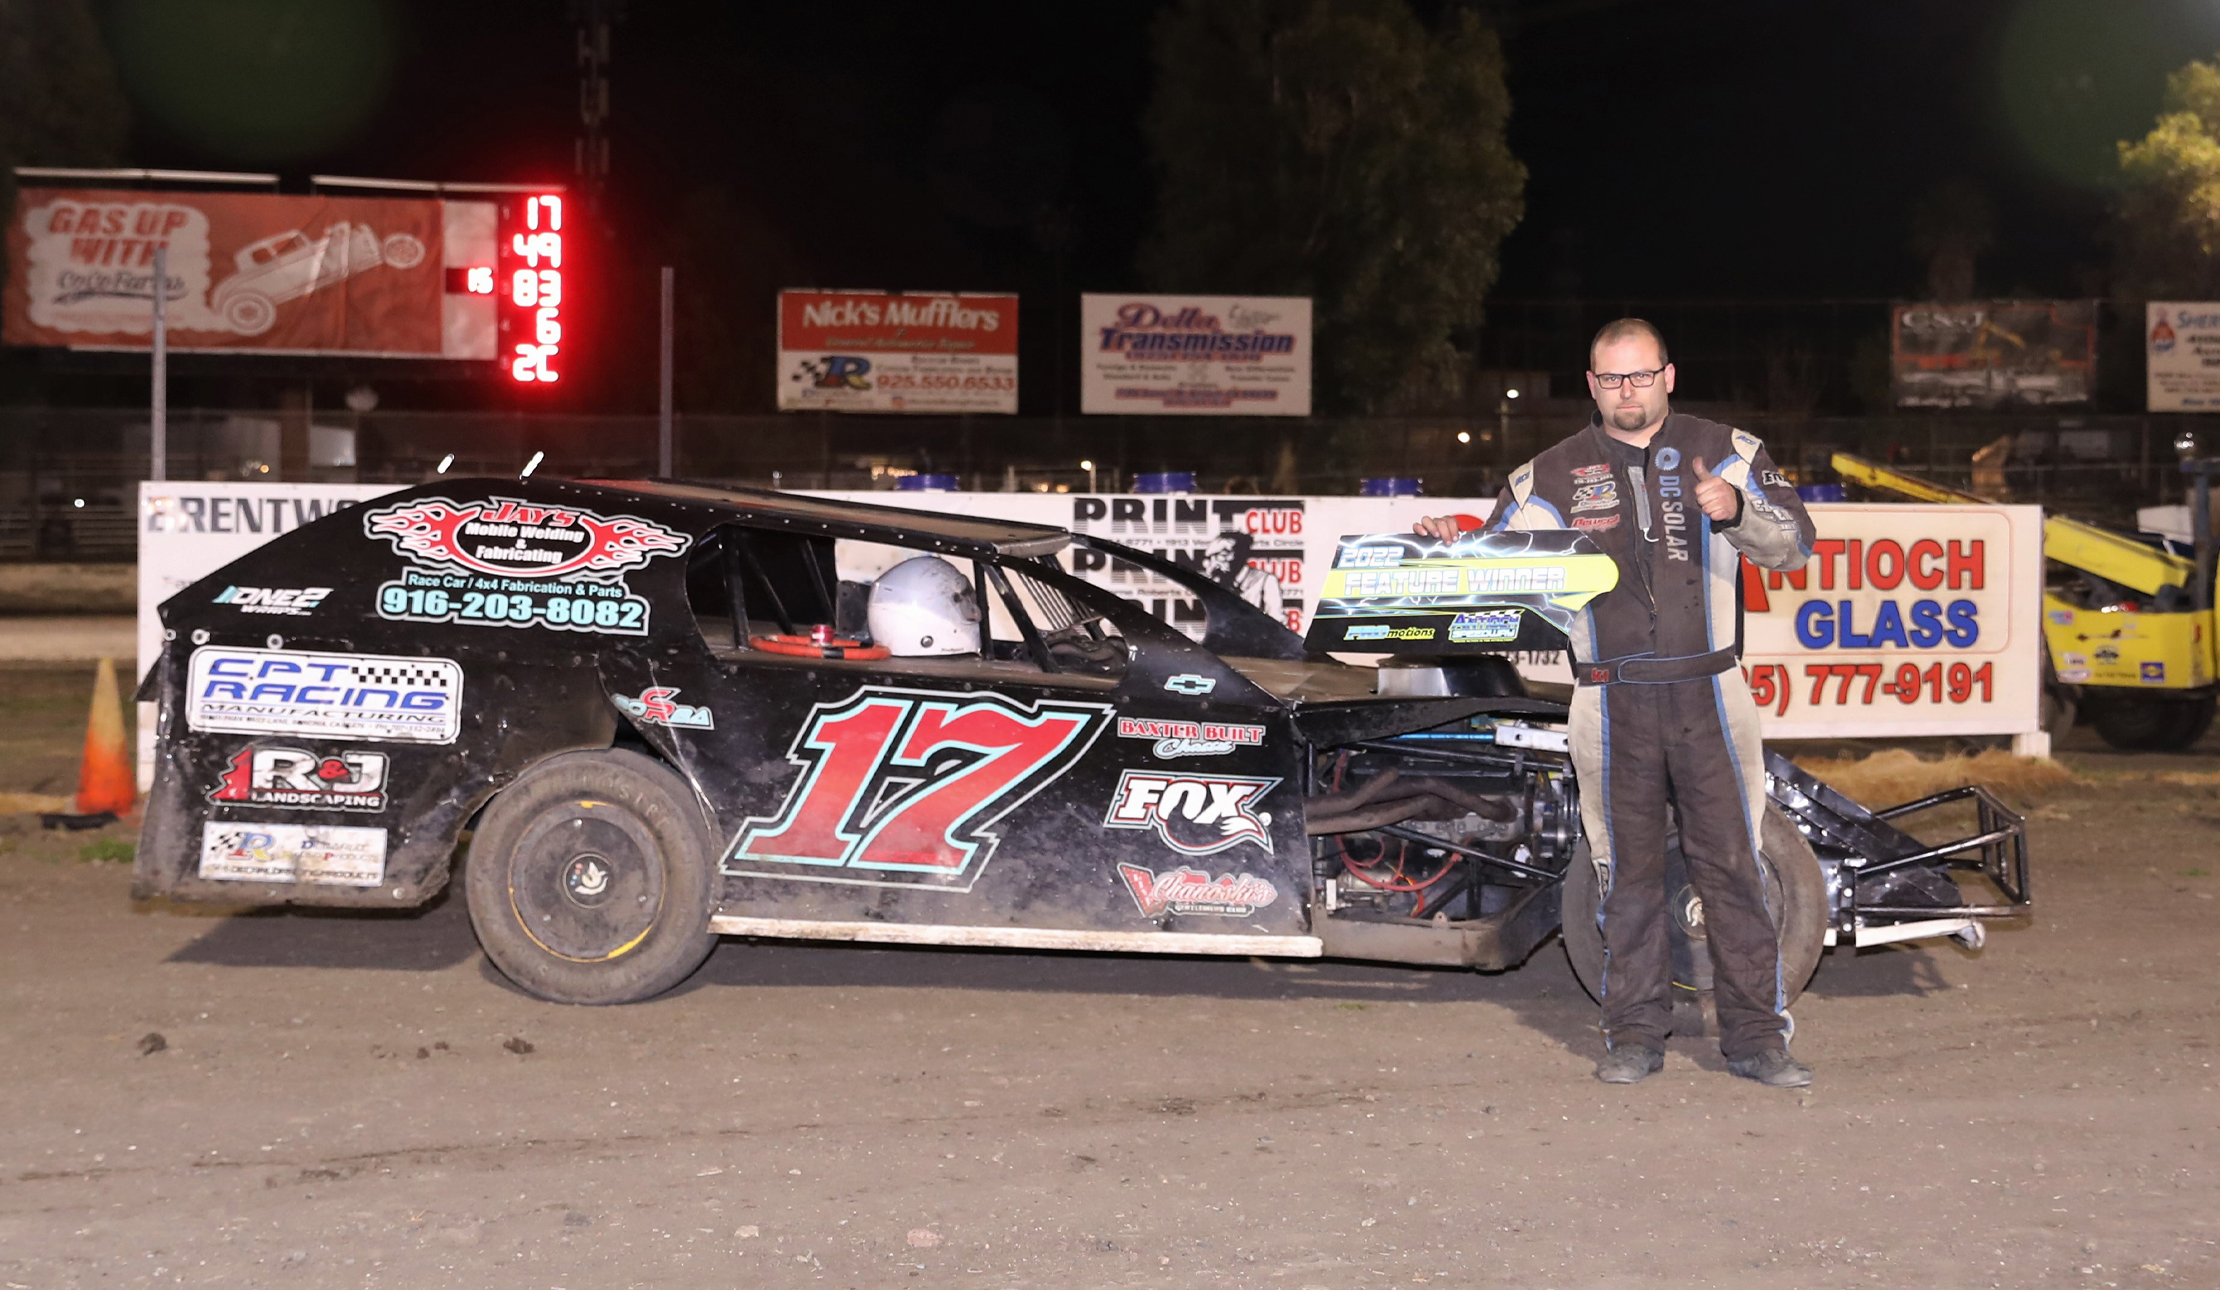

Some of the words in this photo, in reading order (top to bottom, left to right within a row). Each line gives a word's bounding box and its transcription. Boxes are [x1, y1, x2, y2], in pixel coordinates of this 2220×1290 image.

[50, 207, 127, 234] GAS
[134, 210, 188, 236] UP
[527, 195, 562, 231] 17
[513, 232, 562, 268] 49
[513, 269, 562, 307] 83
[536, 307, 562, 344] 6
[803, 300, 880, 327] Nick's
[884, 298, 999, 331] Mufflers
[1100, 328, 1295, 353] Transmission
[1659, 475, 1682, 498] DC
[479, 502, 581, 527] JAY'S
[1074, 498, 1304, 533] PRINT
[1246, 511, 1303, 534] CLUB
[465, 522, 517, 538] Mobile
[520, 525, 584, 543] Welding
[515, 538, 528, 549] &
[1661, 501, 1689, 562] SOLAR
[476, 545, 562, 565] Fabricating
[1339, 546, 1405, 568] 2022
[408, 574, 441, 587] Race
[443, 576, 466, 589] Car
[475, 577, 498, 590] 4x4
[501, 579, 572, 594] Fabrication
[576, 584, 586, 596] &
[589, 585, 623, 599] Parts
[1345, 569, 1460, 596] FEATURE
[1467, 567, 1566, 593] WINNER
[382, 587, 646, 628] 916-203-8082
[1796, 600, 1979, 649] GLASS
[209, 658, 349, 682] CPT
[1806, 662, 1993, 706] 777-9191
[203, 680, 449, 711] RACING
[202, 703, 447, 724] MANUFACTURING
[1121, 720, 1199, 739] BAXTER
[1205, 726, 1263, 742] BUILT
[253, 750, 384, 792] R&J
[252, 792, 381, 807] LANDSCAPING
[735, 697, 1092, 876] 17
[1117, 779, 1257, 825] FOX
